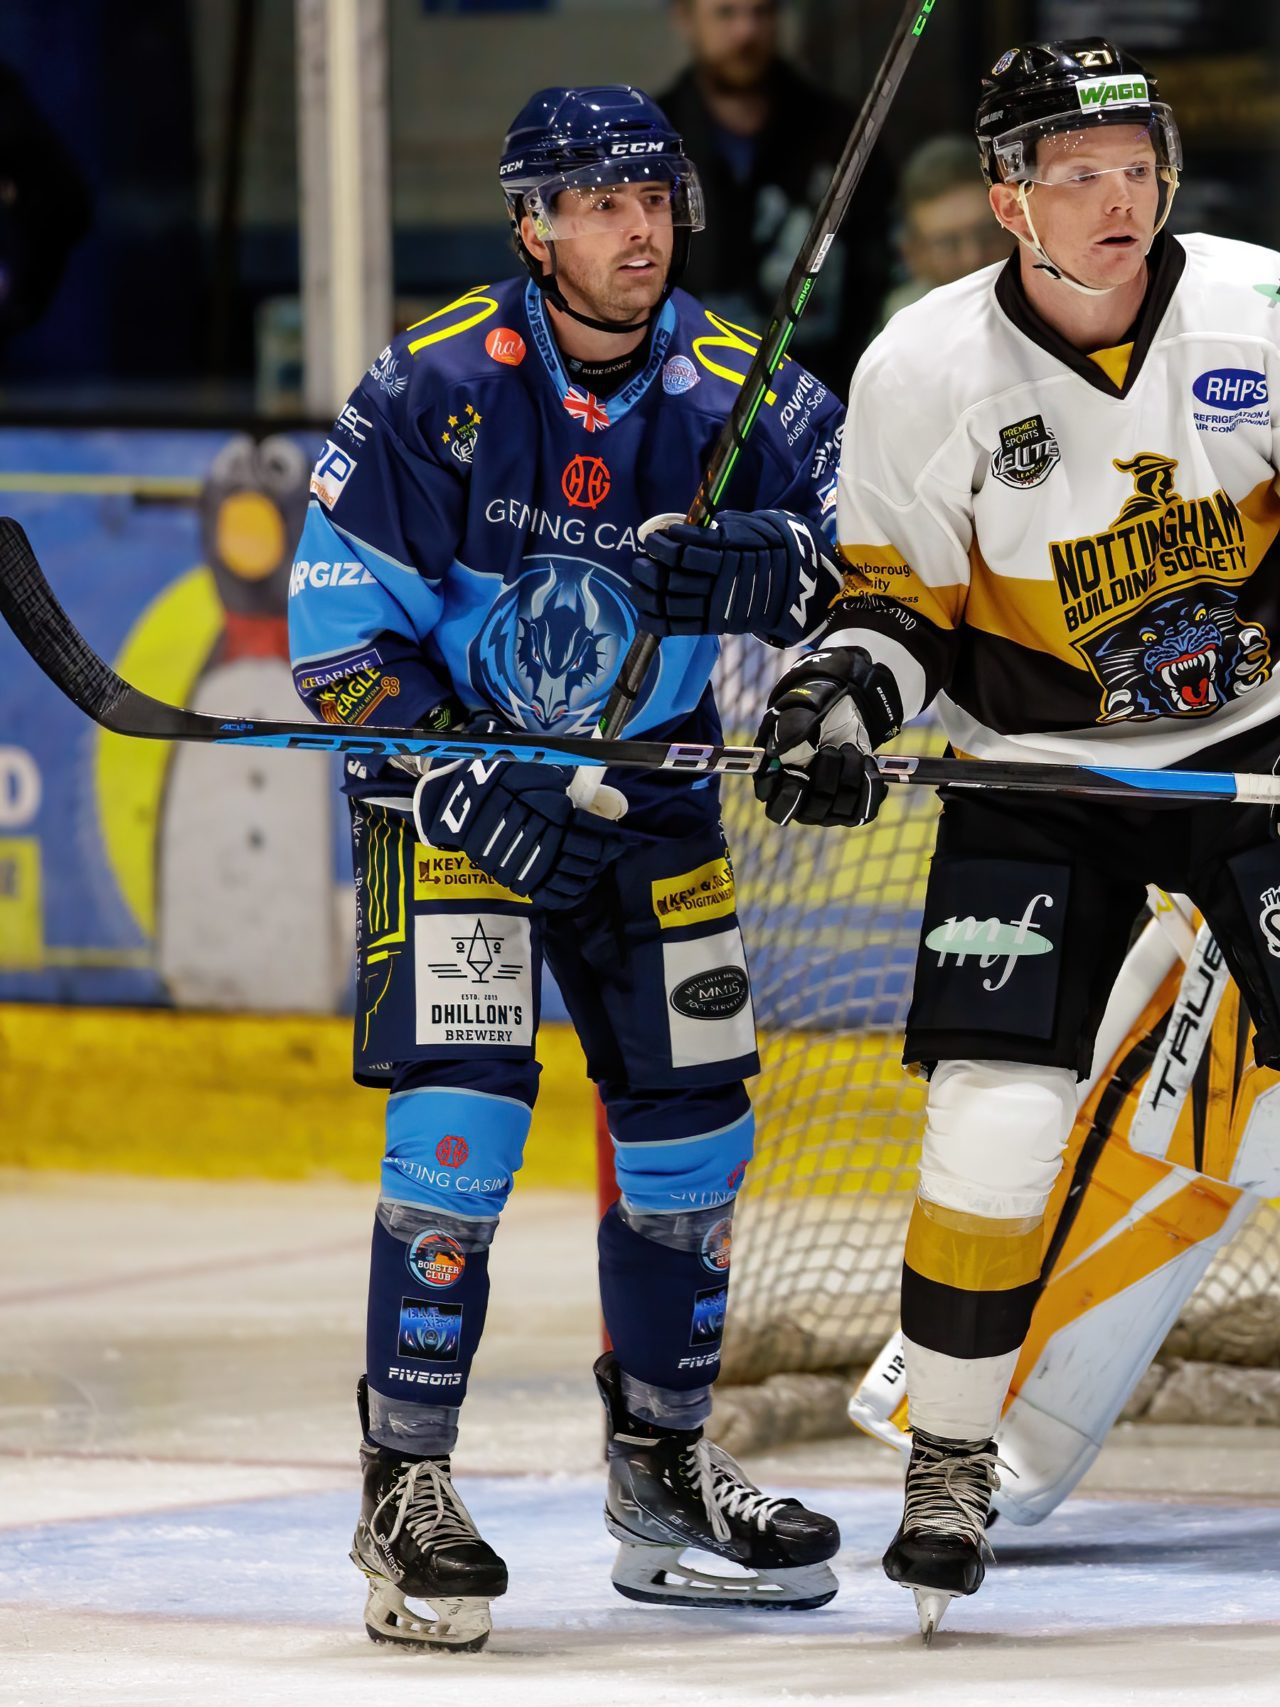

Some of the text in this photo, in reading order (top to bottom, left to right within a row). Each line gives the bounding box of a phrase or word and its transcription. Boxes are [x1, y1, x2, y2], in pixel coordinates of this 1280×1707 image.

[1075, 49, 1113, 67] 27
[1078, 82, 1147, 106] WAGO
[611, 141, 664, 155] CCM
[499, 159, 524, 176] CCM
[1205, 376, 1267, 402] RHPS
[1002, 419, 1038, 439] PREMIER
[1005, 429, 1039, 448] SPORTS
[1000, 440, 1059, 475] ELITE
[1051, 488, 1246, 606] NOTTINGHAM
[1063, 545, 1247, 633] BUILDING SOCIETY
[336, 666, 381, 717] EAGLE
[433, 856, 465, 872] KEY
[444, 873, 495, 885] DIGITAL
[431, 1004, 522, 1025] DHILLON'S
[1150, 935, 1224, 1111] TRUE
[445, 1029, 513, 1042] BREWERY
[417, 1259, 460, 1275] BOOSTER
[425, 1270, 451, 1281] CLUB
